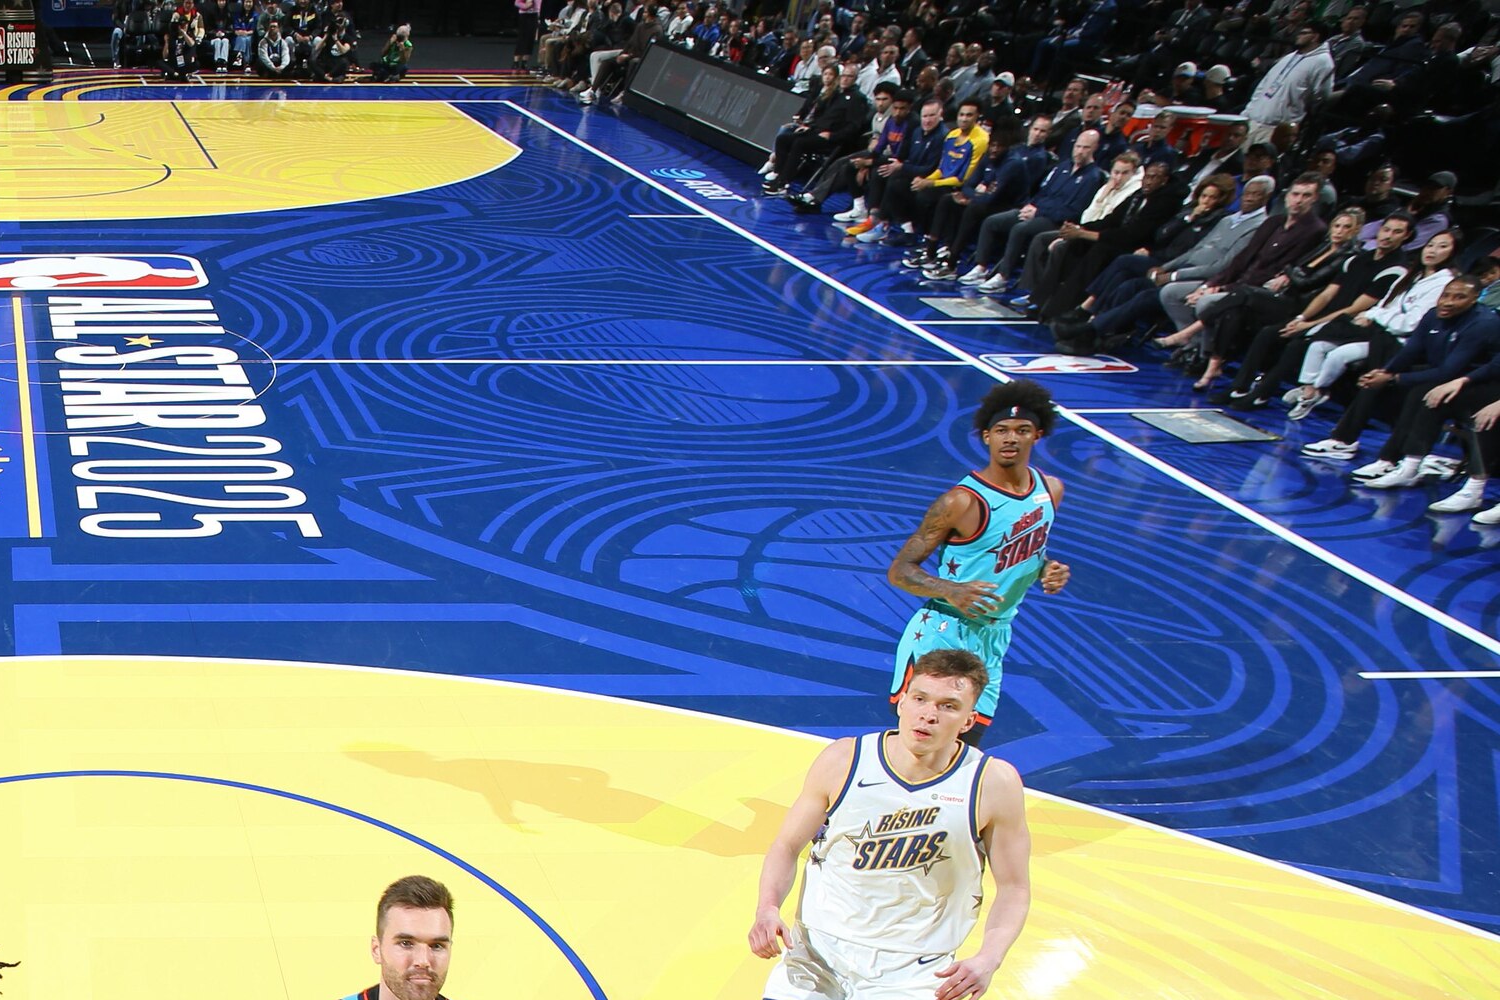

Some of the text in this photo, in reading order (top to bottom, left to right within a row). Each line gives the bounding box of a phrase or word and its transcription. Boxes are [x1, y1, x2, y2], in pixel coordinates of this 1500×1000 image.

[7, 32, 36, 48] RISING
[7, 48, 35, 65] STARS
[675, 179, 747, 202] AT&T
[68, 434, 324, 539] 2025
[875, 806, 941, 834] RISING
[853, 831, 948, 871] STARS
